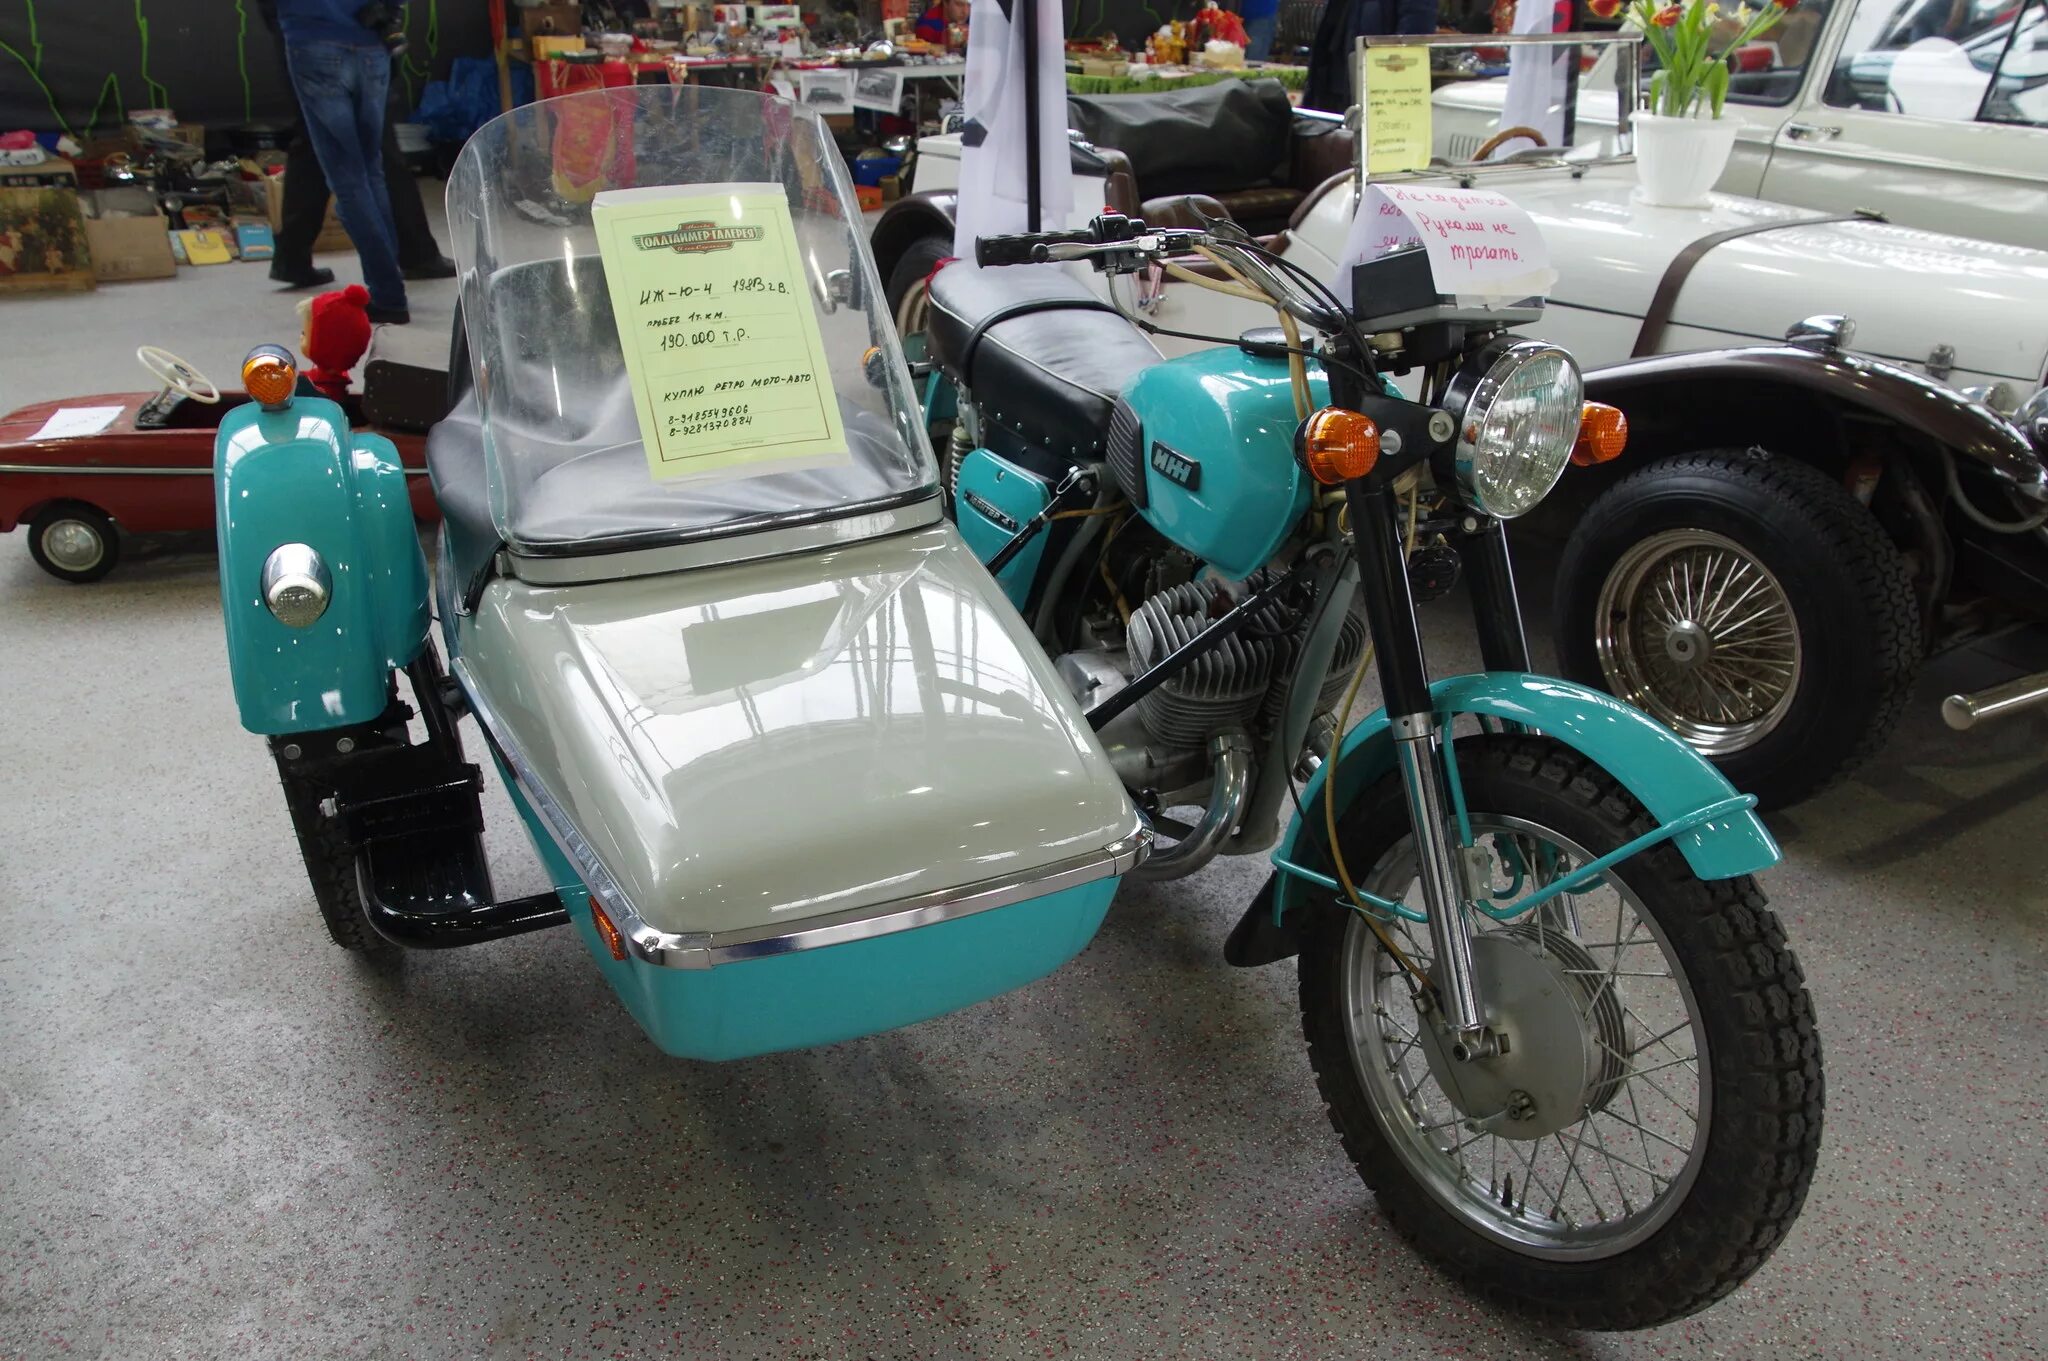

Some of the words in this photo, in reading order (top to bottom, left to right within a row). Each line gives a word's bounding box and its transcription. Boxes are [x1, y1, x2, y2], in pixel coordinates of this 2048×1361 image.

[1416, 211, 1486, 238] Руками
[1492, 223, 1516, 235] не
[660, 330, 716, 351] 190.000
[663, 386, 705, 402] КУПЛЮ
[713, 380, 745, 392] РЕТРО
[751, 374, 812, 388] МОТО-АВТО
[668, 404, 749, 425] 8-9185549606
[669, 416, 753, 437] 8-9281370884
